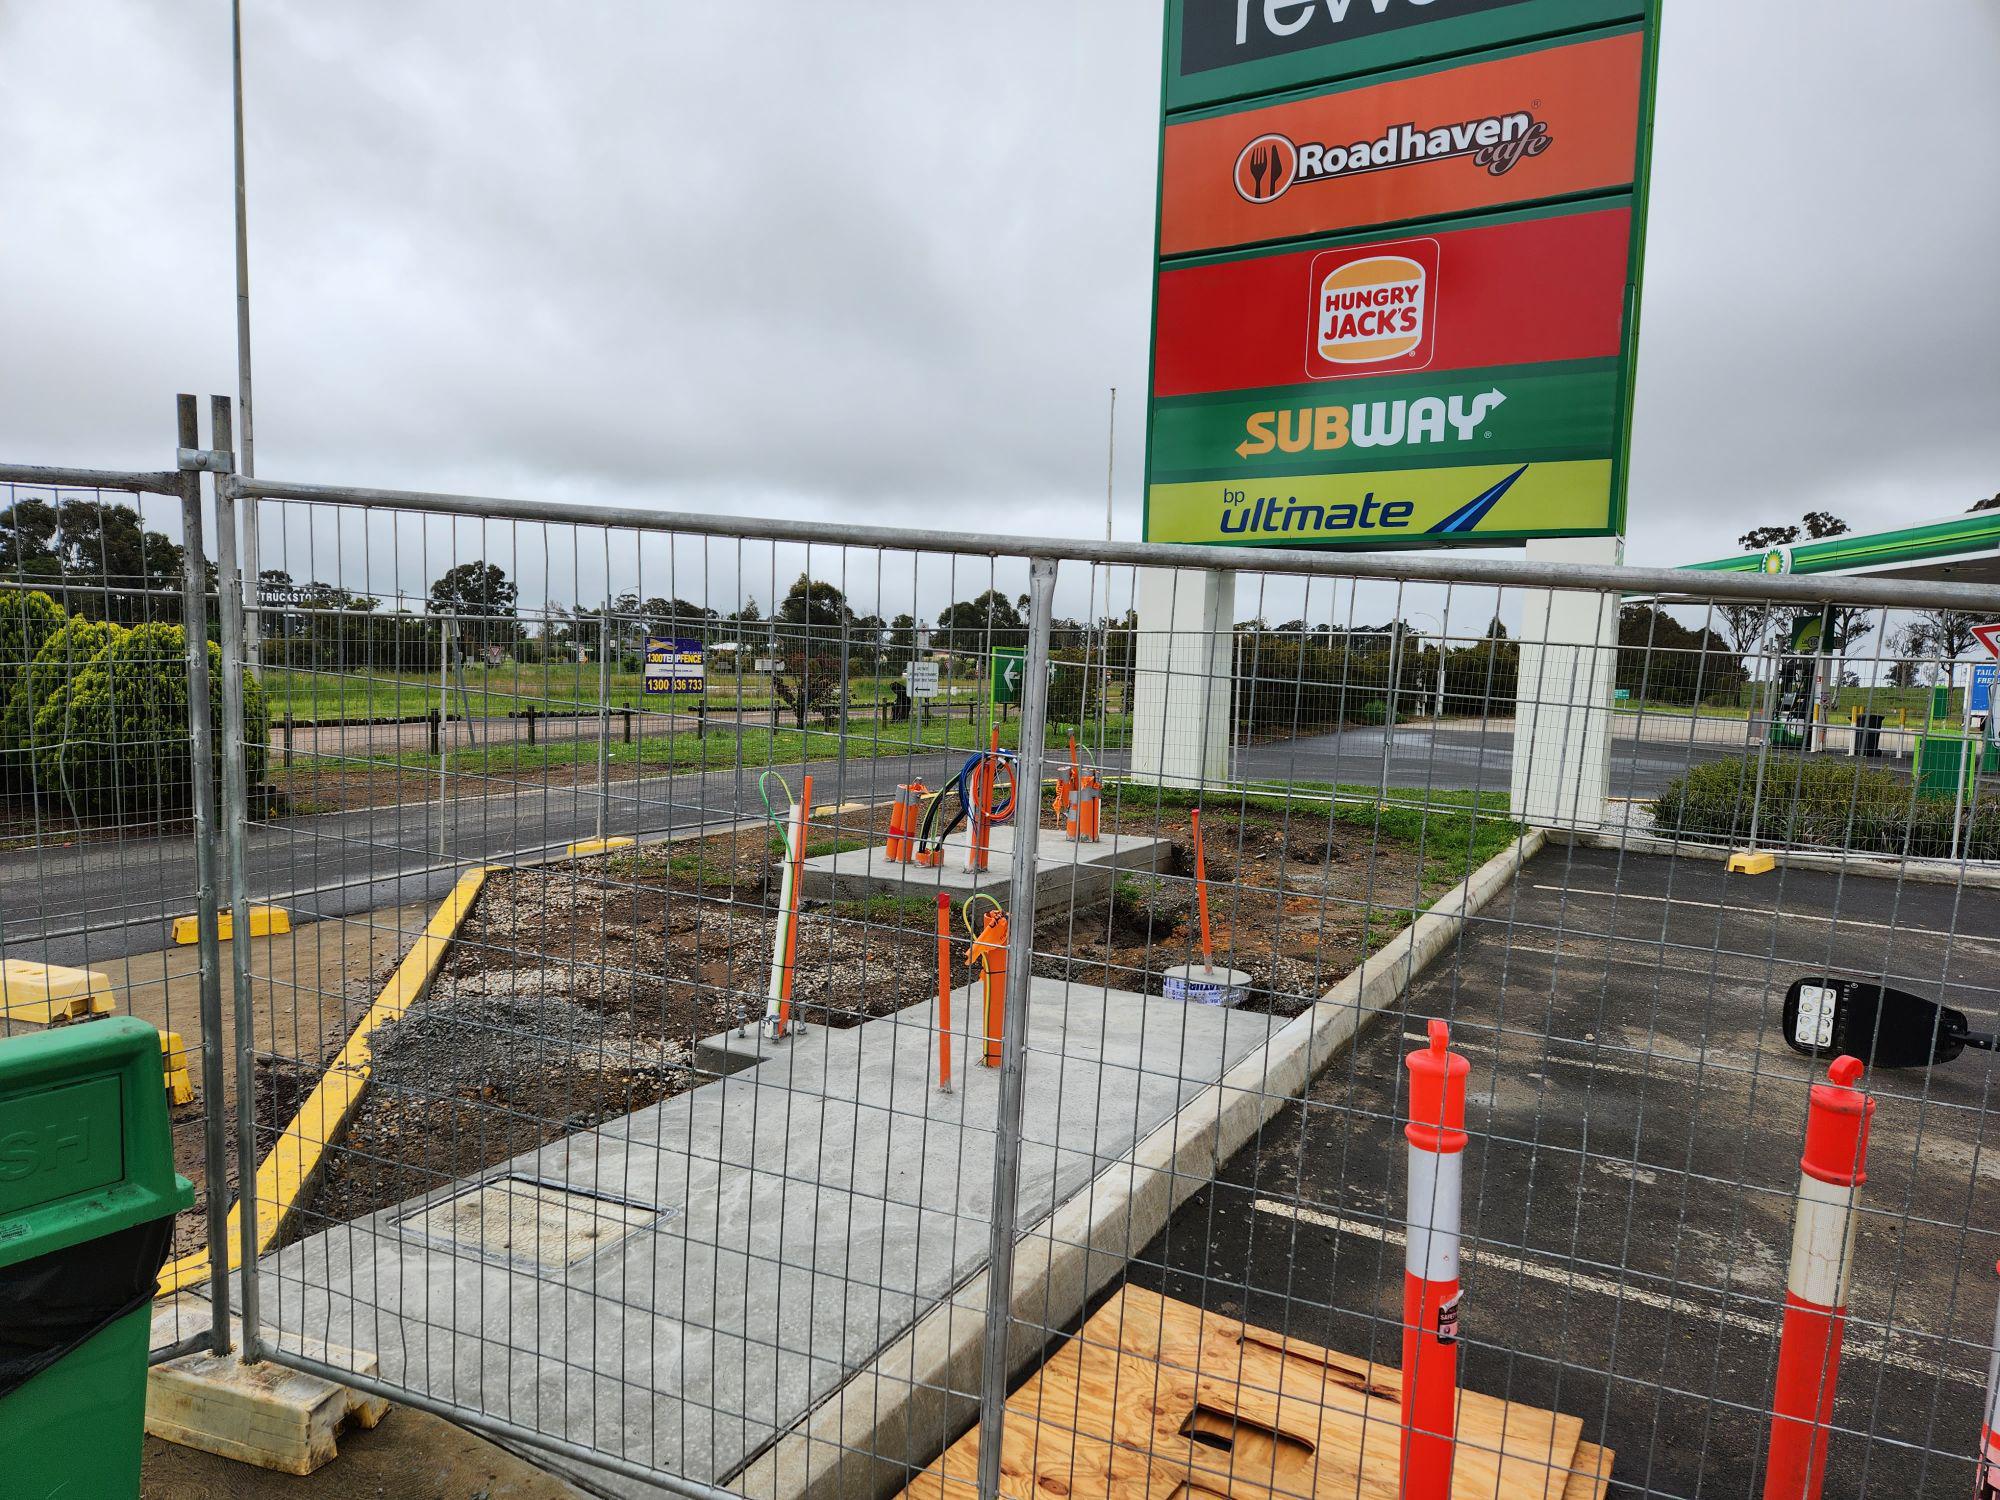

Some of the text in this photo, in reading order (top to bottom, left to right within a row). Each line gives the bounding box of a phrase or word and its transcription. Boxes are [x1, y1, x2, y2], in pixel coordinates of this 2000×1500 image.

[1298, 111, 1530, 178] Roadhaven
[1474, 122, 1549, 175] cafe
[1325, 284, 1419, 312] HUNGRY
[1324, 306, 1417, 340] JACK'S
[1235, 387, 1507, 460] SUBWAY
[1220, 492, 1414, 533] ultimate
[1223, 488, 1245, 504] bp
[648, 679, 669, 690] 1300
[688, 679, 702, 690] 733
